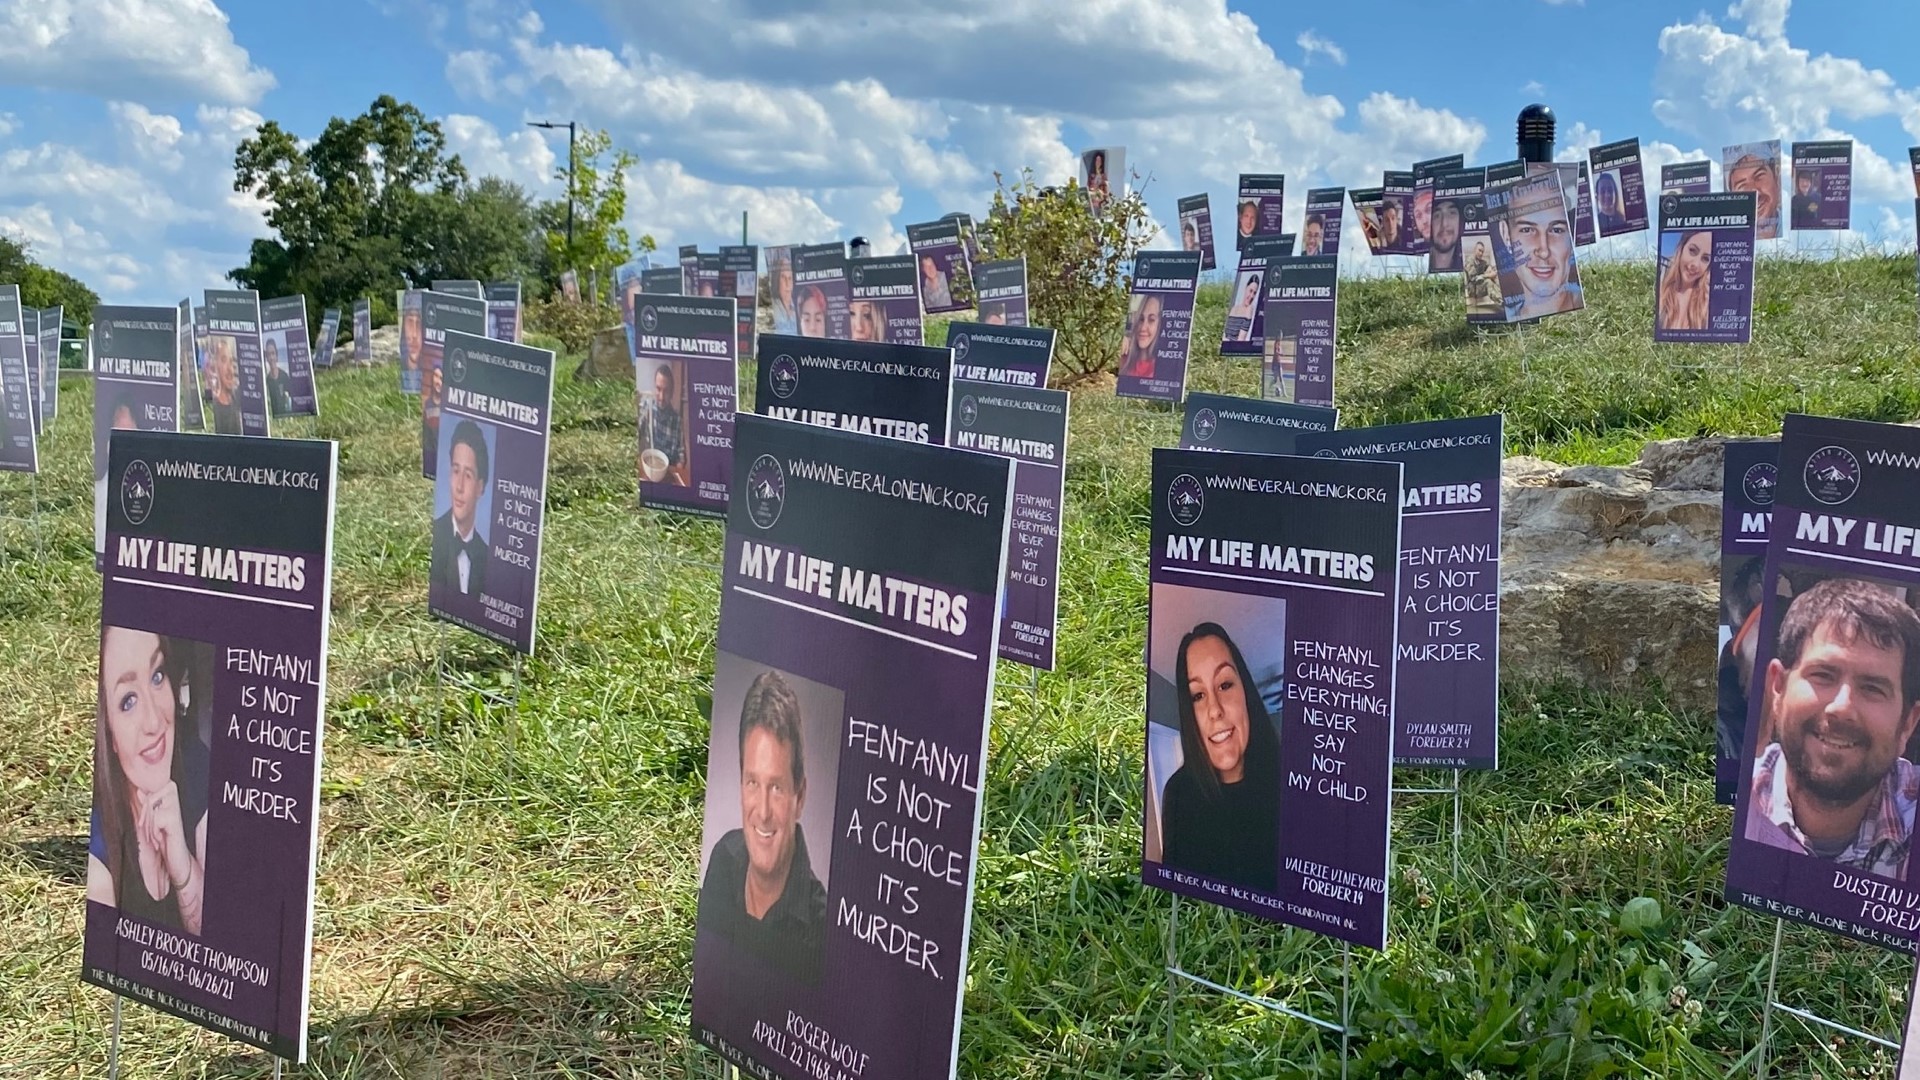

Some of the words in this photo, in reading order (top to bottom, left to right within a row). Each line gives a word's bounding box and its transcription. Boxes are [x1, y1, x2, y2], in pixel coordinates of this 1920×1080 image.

[1604, 160, 1613, 168] LIFE
[1614, 155, 1637, 165] MATTERS
[1456, 186, 1480, 194] MATTERS
[1667, 218, 1682, 226] MY
[1684, 217, 1702, 226] LIFE
[1704, 215, 1747, 225] MATTERS
[853, 287, 865, 297] MY
[866, 286, 879, 296] LIFE
[881, 285, 913, 295] MATTERS
[1136, 279, 1148, 287] MY
[1149, 279, 1161, 288] LIFE
[1162, 279, 1192, 288] MATTERS
[1269, 288, 1280, 297] MY
[1282, 287, 1295, 297] LIFE
[1297, 287, 1330, 296] MATTERS
[889, 318, 921, 327] FENTANYL
[1162, 310, 1192, 318] FENTANYL
[1302, 320, 1330, 328] FENTANYL
[210, 320, 219, 329] MY
[220, 320, 230, 330] LIFE
[231, 320, 255, 331] MATTERS
[902, 329, 916, 337] NOT
[642, 335, 657, 348] MY
[660, 336, 679, 350] LIFE
[682, 338, 727, 354] MATTERS
[1304, 347, 1322, 355] NEVER
[100, 357, 114, 373] MY
[115, 358, 130, 374] LIFE
[133, 360, 170, 378] MATTERS
[967, 365, 986, 379] LIFE
[988, 368, 1037, 385] MATTERS
[694, 383, 736, 397] FENTANYL
[145, 403, 173, 422] NEVER
[448, 387, 466, 406] MY
[467, 392, 487, 412] LIFE
[489, 398, 538, 425] MATTERS
[702, 398, 709, 407] IS
[711, 397, 729, 408] NOT
[699, 409, 705, 420] A
[707, 410, 736, 422] CHOICE
[707, 424, 722, 434] IT'S
[841, 414, 929, 443] MATTERS
[958, 431, 976, 447] MY
[978, 434, 999, 452] LIFE
[1002, 437, 1054, 459] MATTERS
[498, 479, 541, 503] FENTANYL
[1016, 493, 1055, 509] FENTANYL
[504, 499, 512, 510] IS
[515, 500, 532, 517] NOT
[1016, 506, 1052, 521] CHANGES
[498, 512, 504, 525] A
[506, 516, 537, 537] CHOICE
[1796, 513, 1857, 546] MY
[508, 535, 523, 549] IT'S
[1019, 533, 1044, 547] NEVER
[1023, 548, 1038, 559] SAY
[1166, 534, 1204, 562] MY
[1210, 538, 1254, 568] LIFE
[1259, 544, 1374, 582] MATTERS
[117, 537, 152, 569] MY
[157, 541, 197, 576] LIFE
[200, 547, 306, 591] MATTERS
[1022, 559, 1038, 572] NOT
[1010, 570, 1022, 582] MY
[1414, 572, 1430, 589] IS
[1439, 570, 1480, 588] NOT
[739, 540, 782, 584] MY
[785, 552, 834, 599] LIFE
[837, 566, 968, 636] MATTERS
[1404, 596, 1417, 613] A
[1425, 593, 1497, 611] CHOICE
[1428, 620, 1462, 637] IT'S
[1293, 640, 1380, 668] FENTANYL
[227, 647, 320, 686] FENTANYL
[1297, 663, 1374, 689] CHANGES
[242, 686, 256, 707] IS
[263, 686, 302, 716] NOT
[1303, 707, 1357, 734] NEVER
[1406, 723, 1438, 734] DYLAN
[1439, 723, 1472, 735] SMITH
[228, 714, 240, 739] A
[247, 719, 311, 754] CHOICE
[1314, 734, 1345, 753] SAY
[1410, 736, 1454, 748] FOREVER
[849, 717, 977, 793] FENTANYL
[1312, 753, 1346, 775] NOT
[252, 757, 282, 782] IT'S
[1288, 771, 1311, 791] MY
[866, 774, 887, 803] IS
[897, 779, 951, 829] NOT
[846, 808, 862, 844] A
[872, 821, 962, 886] CHOICE
[1285, 857, 1329, 879] VALERIE
[1331, 868, 1386, 893] VINEYARD
[878, 873, 919, 914] IT'S
[1157, 868, 1172, 879] THE
[1174, 872, 1200, 887] NEVER
[1202, 880, 1228, 894] ALONE
[1231, 886, 1249, 900] NICK
[1251, 893, 1285, 910] RUCKER
[1288, 903, 1340, 925] FOUNDATION
[1302, 876, 1351, 902] FOREVER
[1353, 890, 1363, 905] 19
[1834, 870, 1903, 905] DUSTIN
[1742, 893, 1762, 906] THE
[1767, 900, 1804, 919] NEVER
[1808, 912, 1847, 931] ALONE
[1852, 924, 1878, 940] NICK
[1883, 934, 1919, 952] RUCK
[1860, 900, 1920, 931] FOREV
[837, 897, 944, 980] MURDER.
[115, 917, 154, 946] ASHLEY
[156, 930, 201, 963] BROOKE
[203, 947, 269, 987] THOMPSON
[92, 968, 104, 980] THE
[106, 973, 129, 991] NEVER
[132, 983, 156, 1000] ALONE
[158, 992, 174, 1006] NICK
[176, 999, 206, 1021] RUCKER
[208, 1012, 256, 1038] FOUNDATION
[702, 1029, 715, 1045] THE
[719, 1038, 743, 1064] NEVER
[752, 1020, 786, 1058] APRIL
[790, 1042, 803, 1067] 22
[786, 1009, 830, 1052] ROGER
[831, 1039, 869, 1076] WOLF
